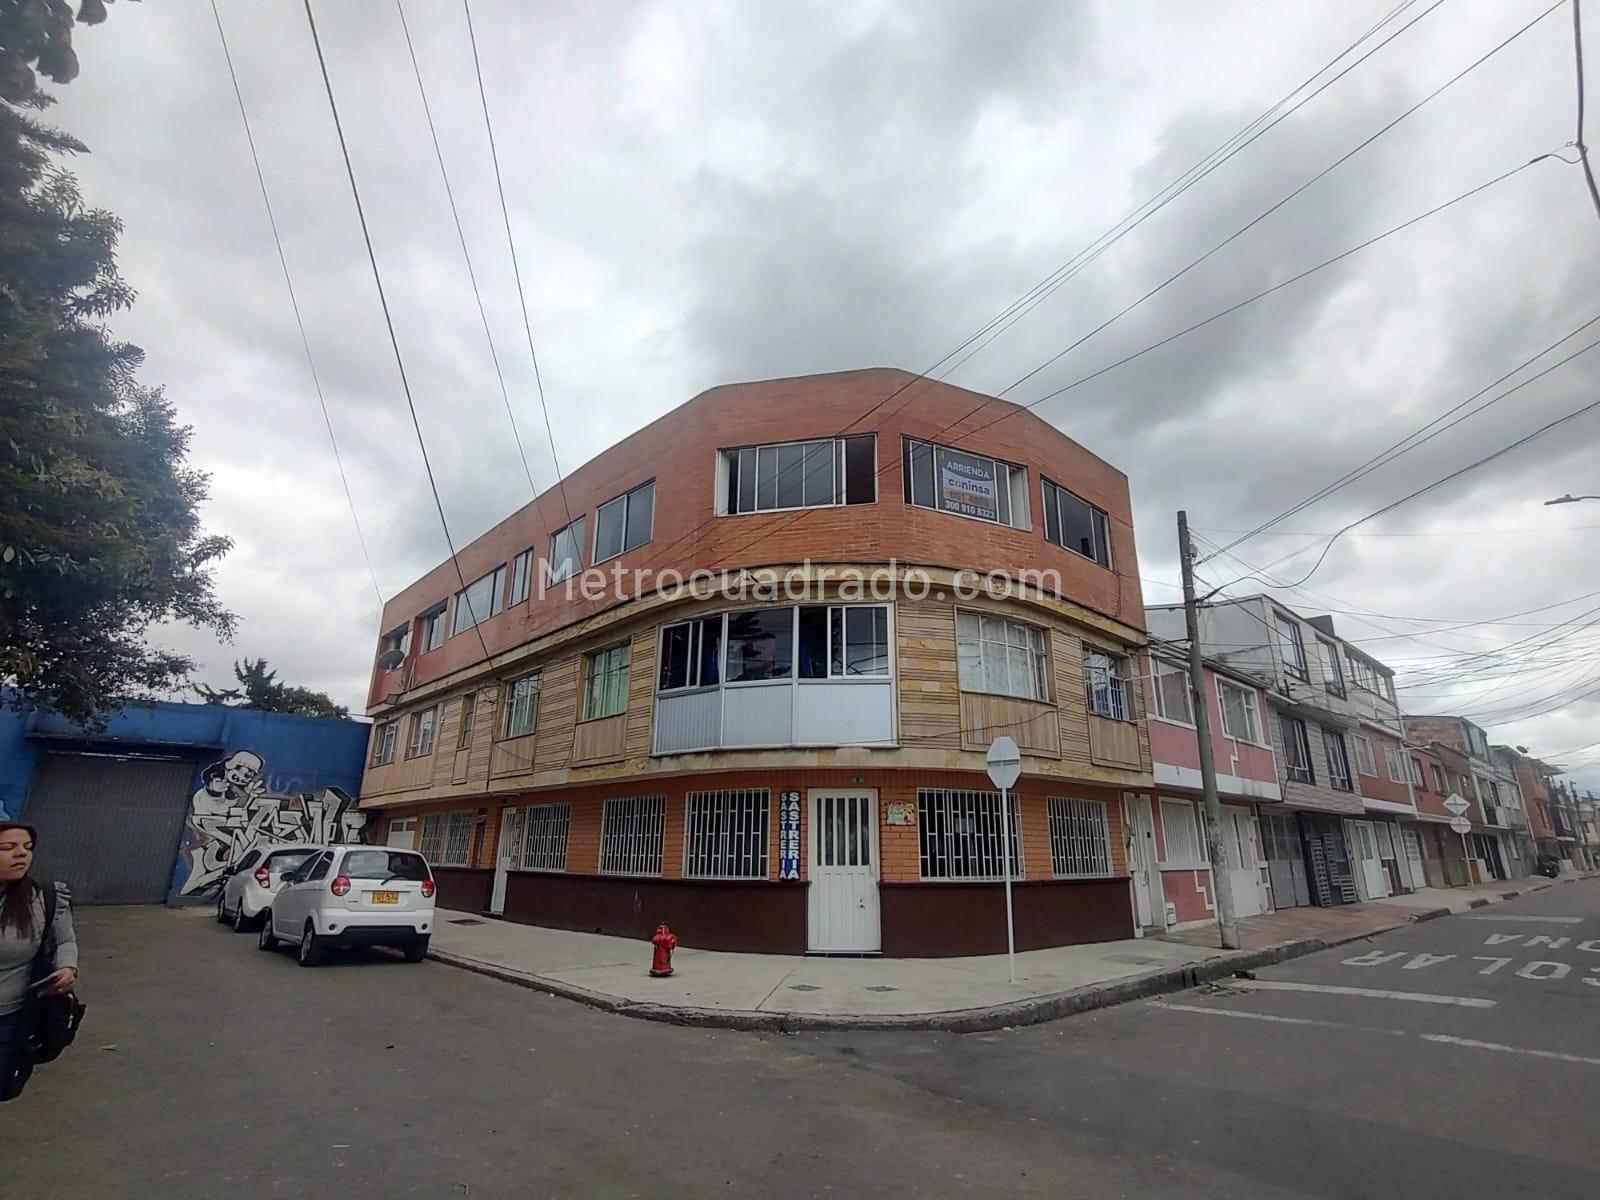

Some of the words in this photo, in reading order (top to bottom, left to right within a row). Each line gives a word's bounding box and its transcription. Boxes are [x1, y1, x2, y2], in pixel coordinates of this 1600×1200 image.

[946, 461, 990, 479] ARRIENDA
[948, 479, 990, 495] coninsa
[788, 792, 800, 879] SASTRERIA
